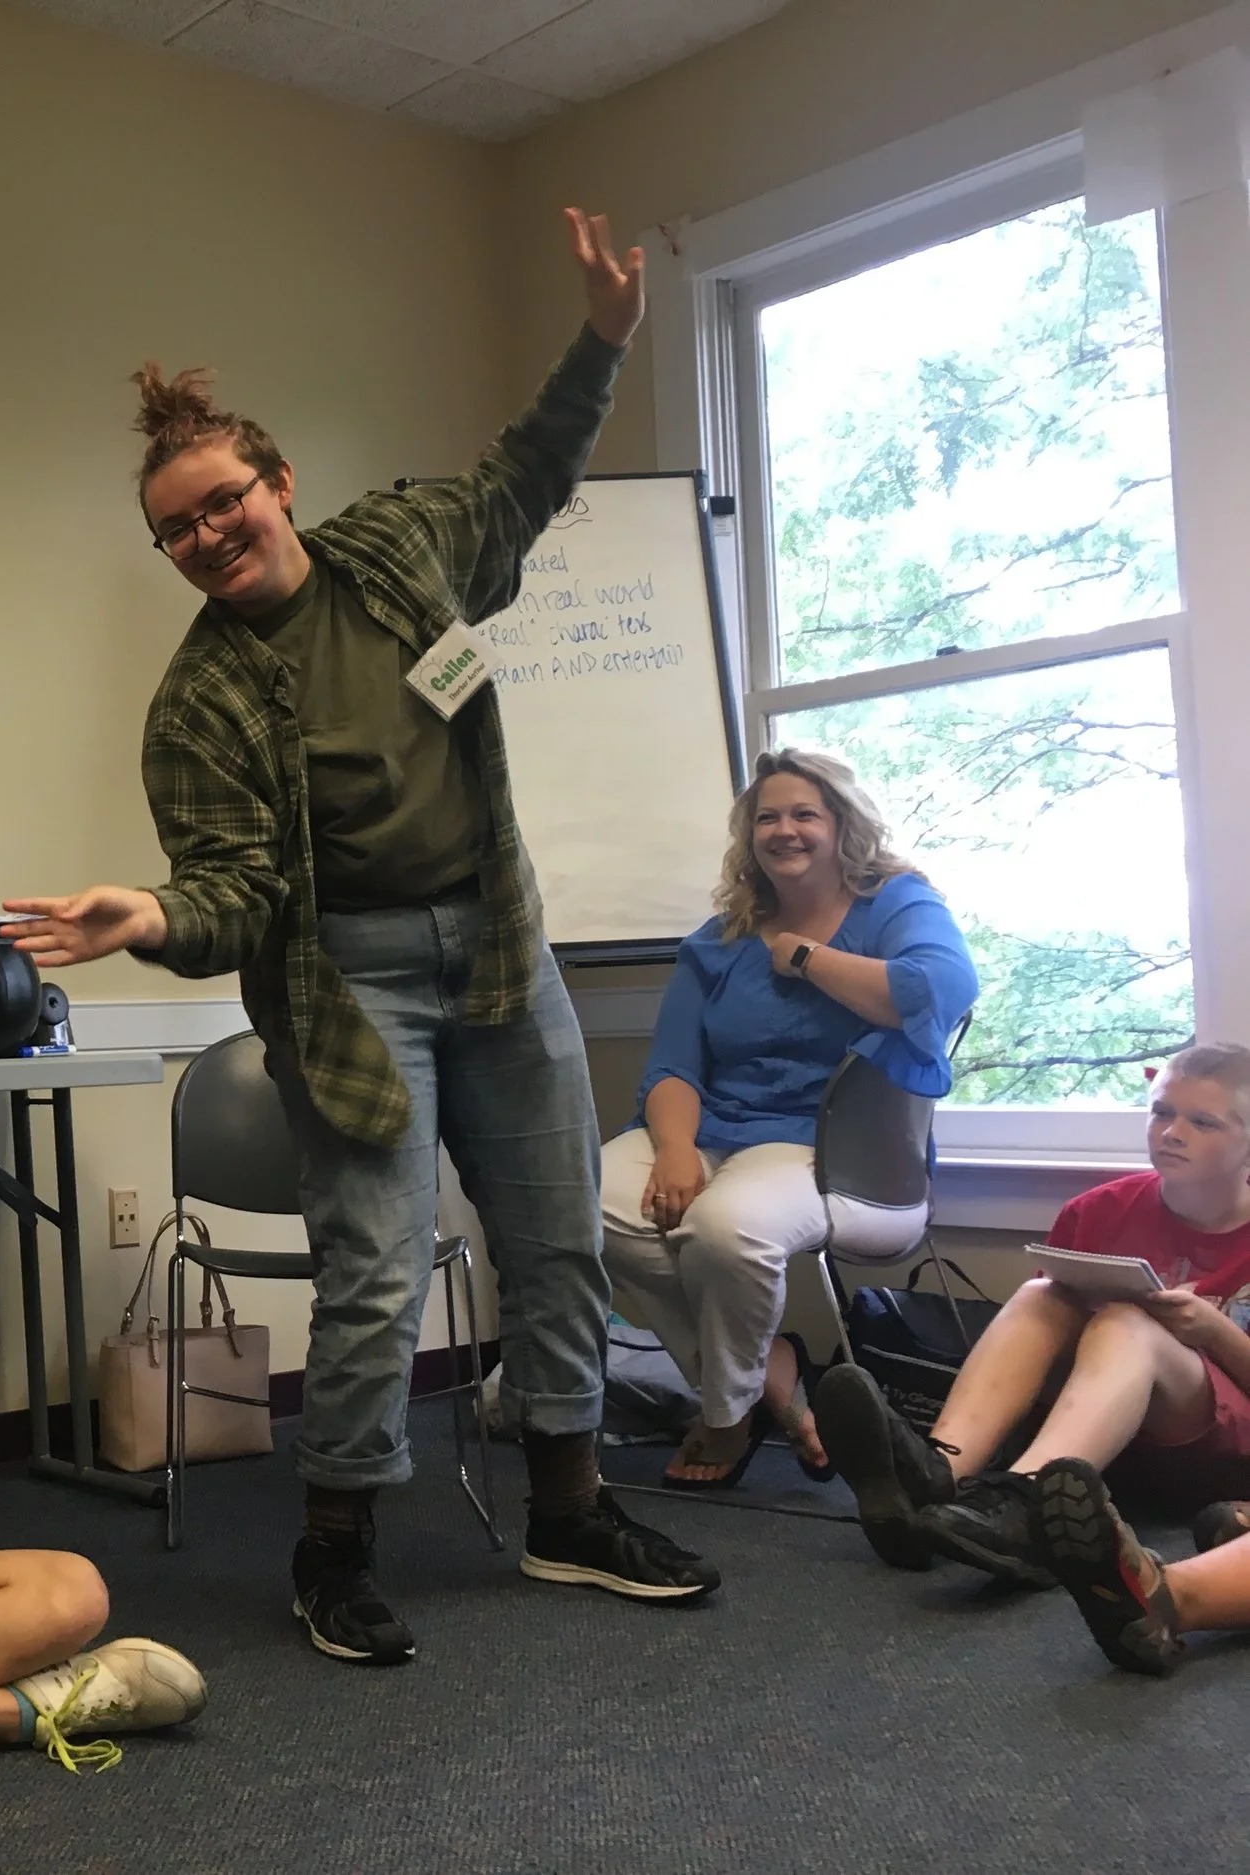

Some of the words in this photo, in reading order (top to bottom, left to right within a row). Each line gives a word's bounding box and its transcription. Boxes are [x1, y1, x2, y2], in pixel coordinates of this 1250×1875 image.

[545, 579, 588, 611] real
[595, 573, 654, 605] world
[430, 648, 477, 692] Callen
[552, 652, 597, 681] AND
